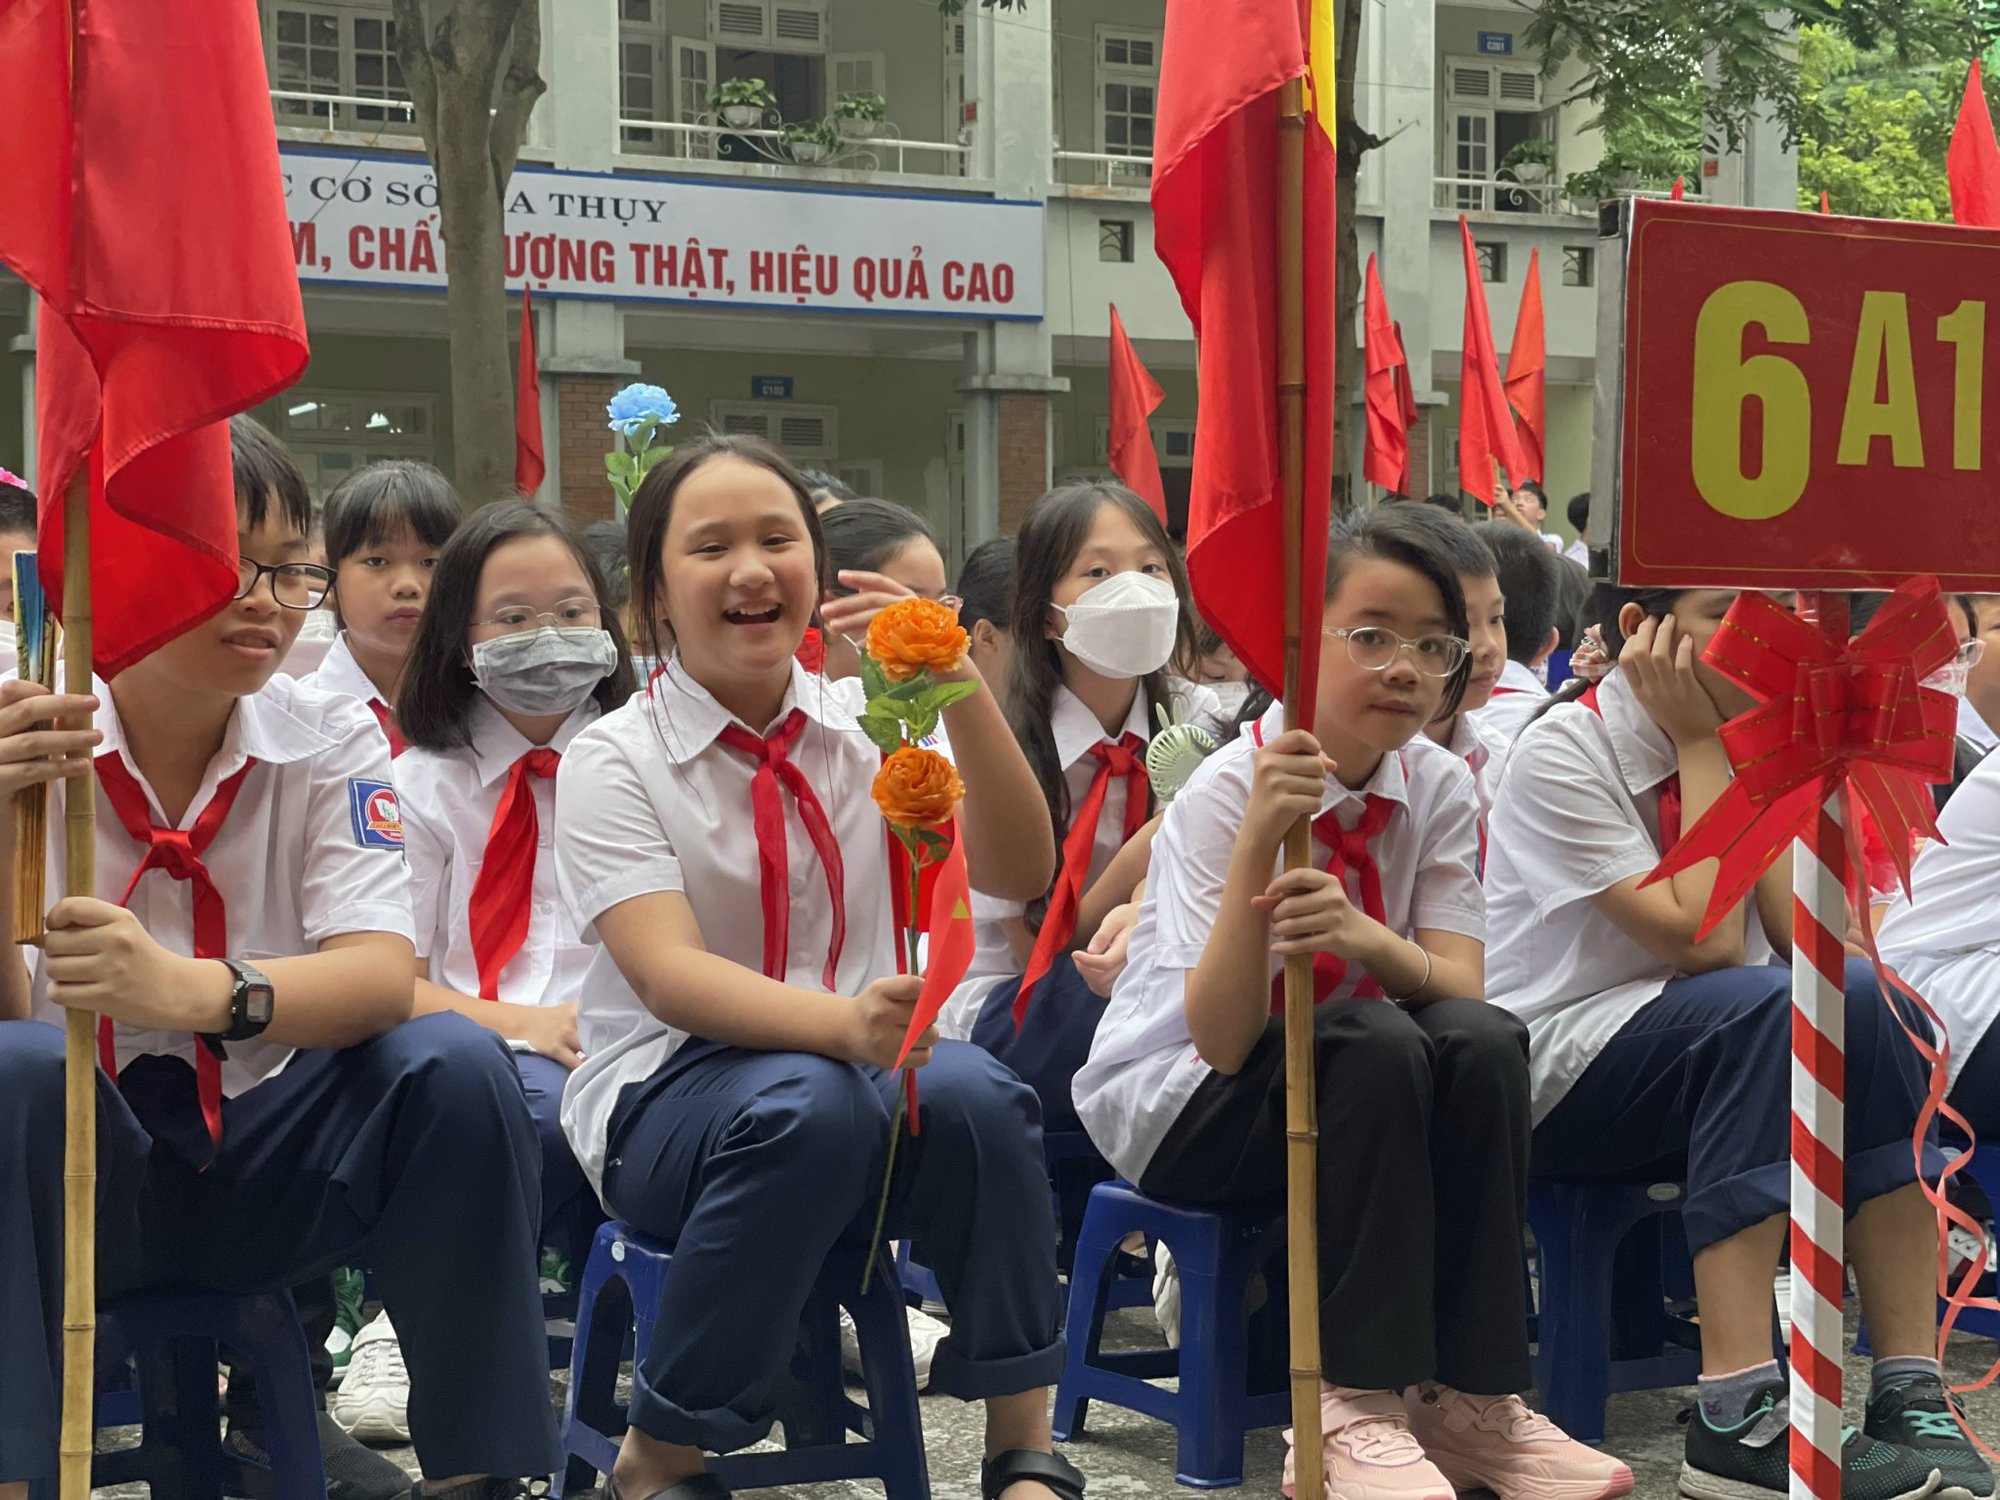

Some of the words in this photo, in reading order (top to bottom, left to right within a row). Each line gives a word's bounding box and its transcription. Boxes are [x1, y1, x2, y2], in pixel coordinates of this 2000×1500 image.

[310, 176, 372, 203] CƠ
[548, 193, 667, 227] THỤY
[349, 213, 449, 275] CHẤ
[503, 231, 616, 290] ƯỢNG
[629, 237, 735, 298] THẬT,
[749, 244, 839, 304] HIỆU
[853, 245, 930, 303] QUẢ
[942, 260, 1014, 304] CAO
